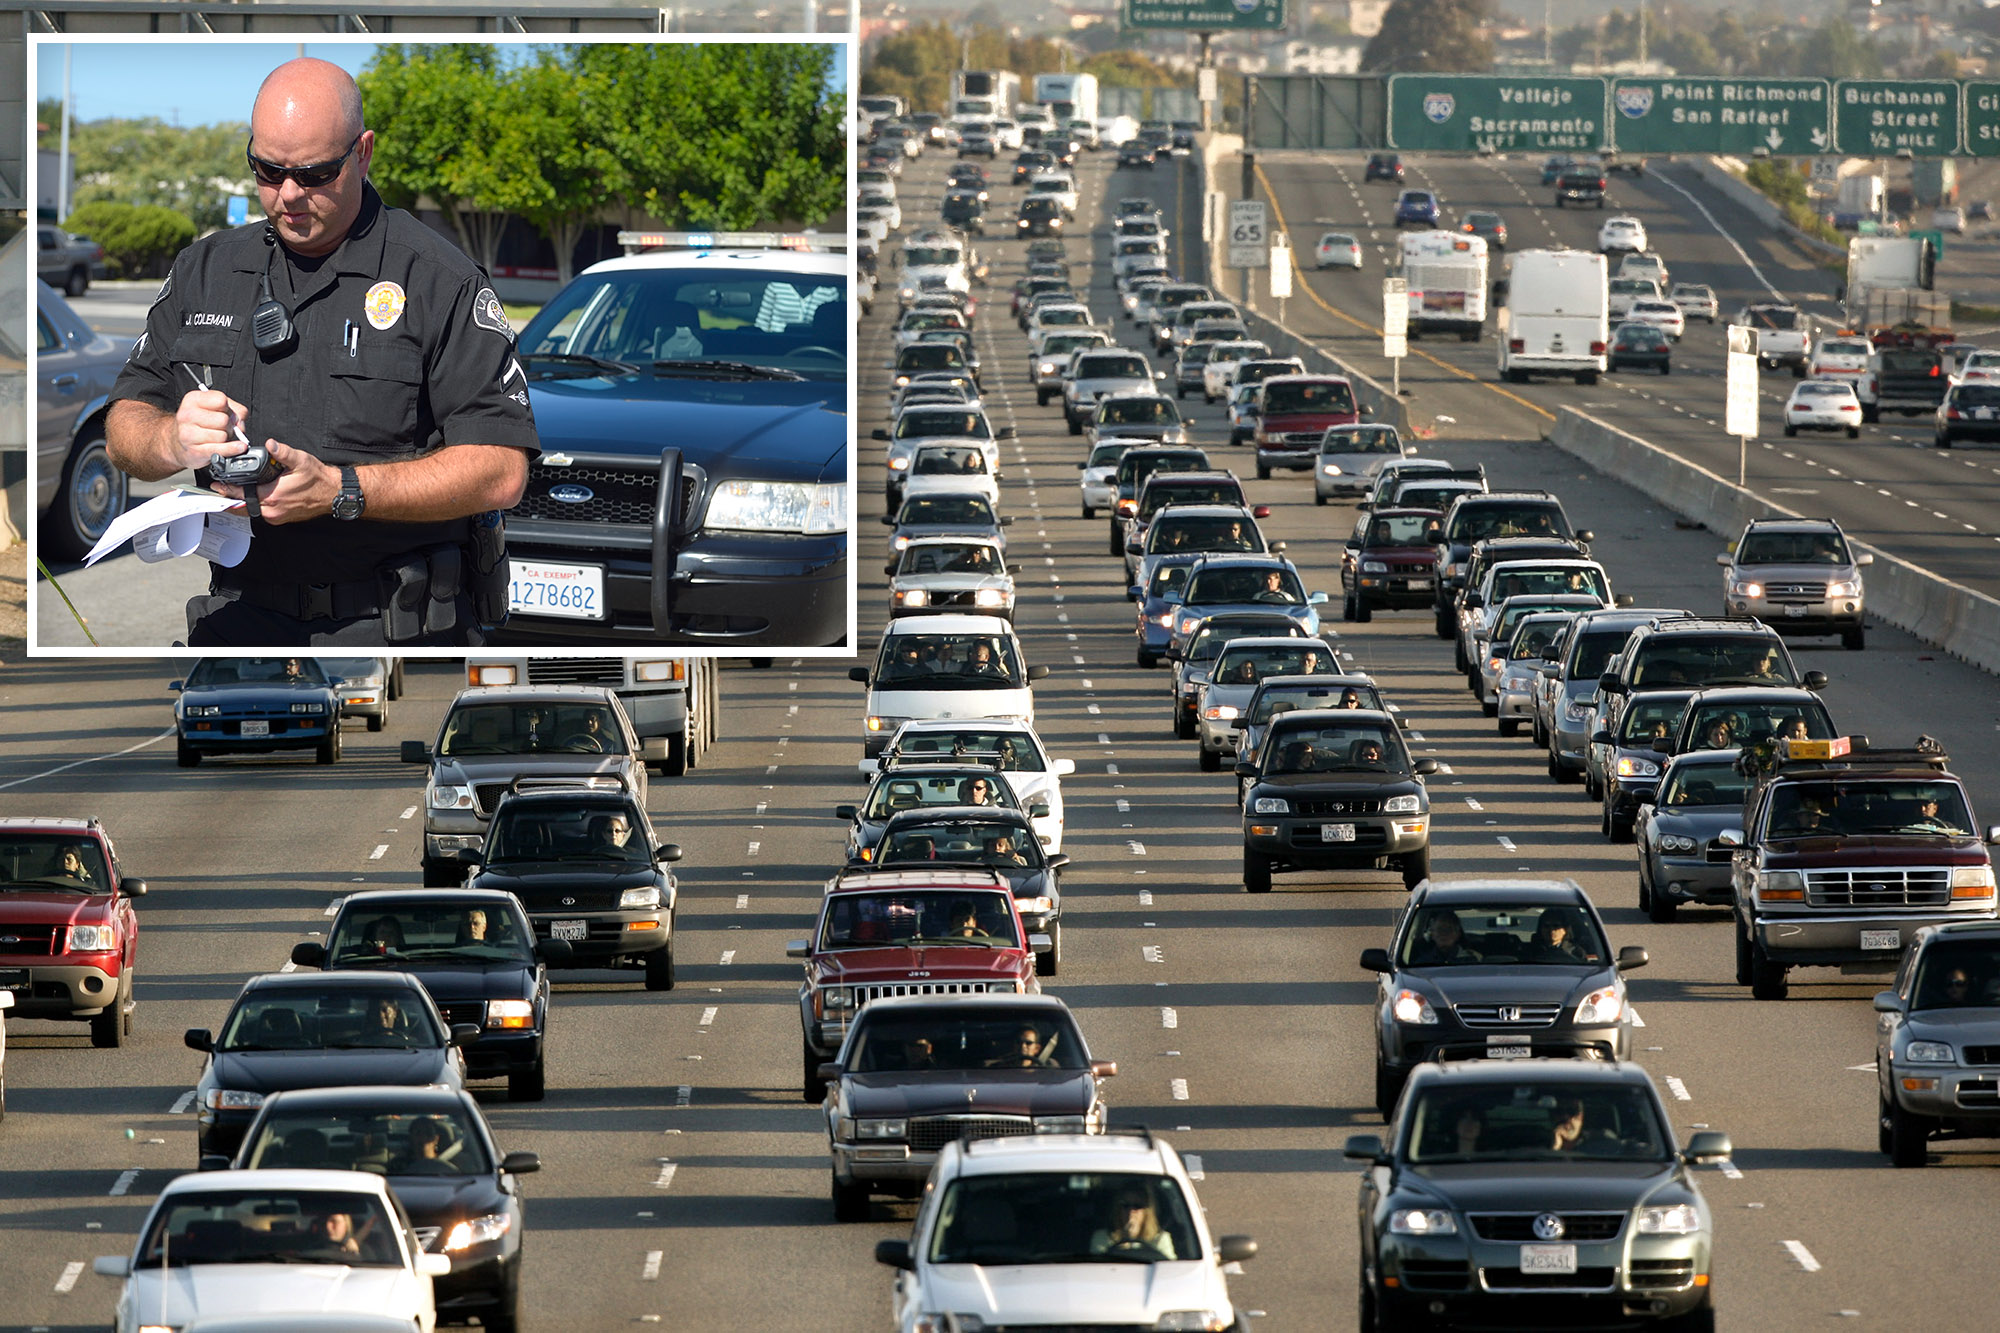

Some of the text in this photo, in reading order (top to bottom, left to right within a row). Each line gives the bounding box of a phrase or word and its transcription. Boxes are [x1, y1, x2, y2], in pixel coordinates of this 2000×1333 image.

[1133, 10, 1184, 22] Central
[1187, 10, 1235, 22] Avenue
[1499, 87, 1573, 107] Vallejo
[1661, 83, 1822, 102] Point Richmond
[1844, 88, 1947, 105] Buchanan
[1469, 116, 1595, 133] Sacramento
[1672, 107, 1790, 126] San Rafael
[1871, 109, 1940, 127] Street
[1536, 134, 1588, 148] LANES
[1895, 133, 1936, 147] MILE
[1233, 225, 1262, 242] 65
[193, 313, 234, 328] COLEMAN
[527, 569, 578, 581] CA EXEMPT
[511, 580, 596, 610] 1278682
